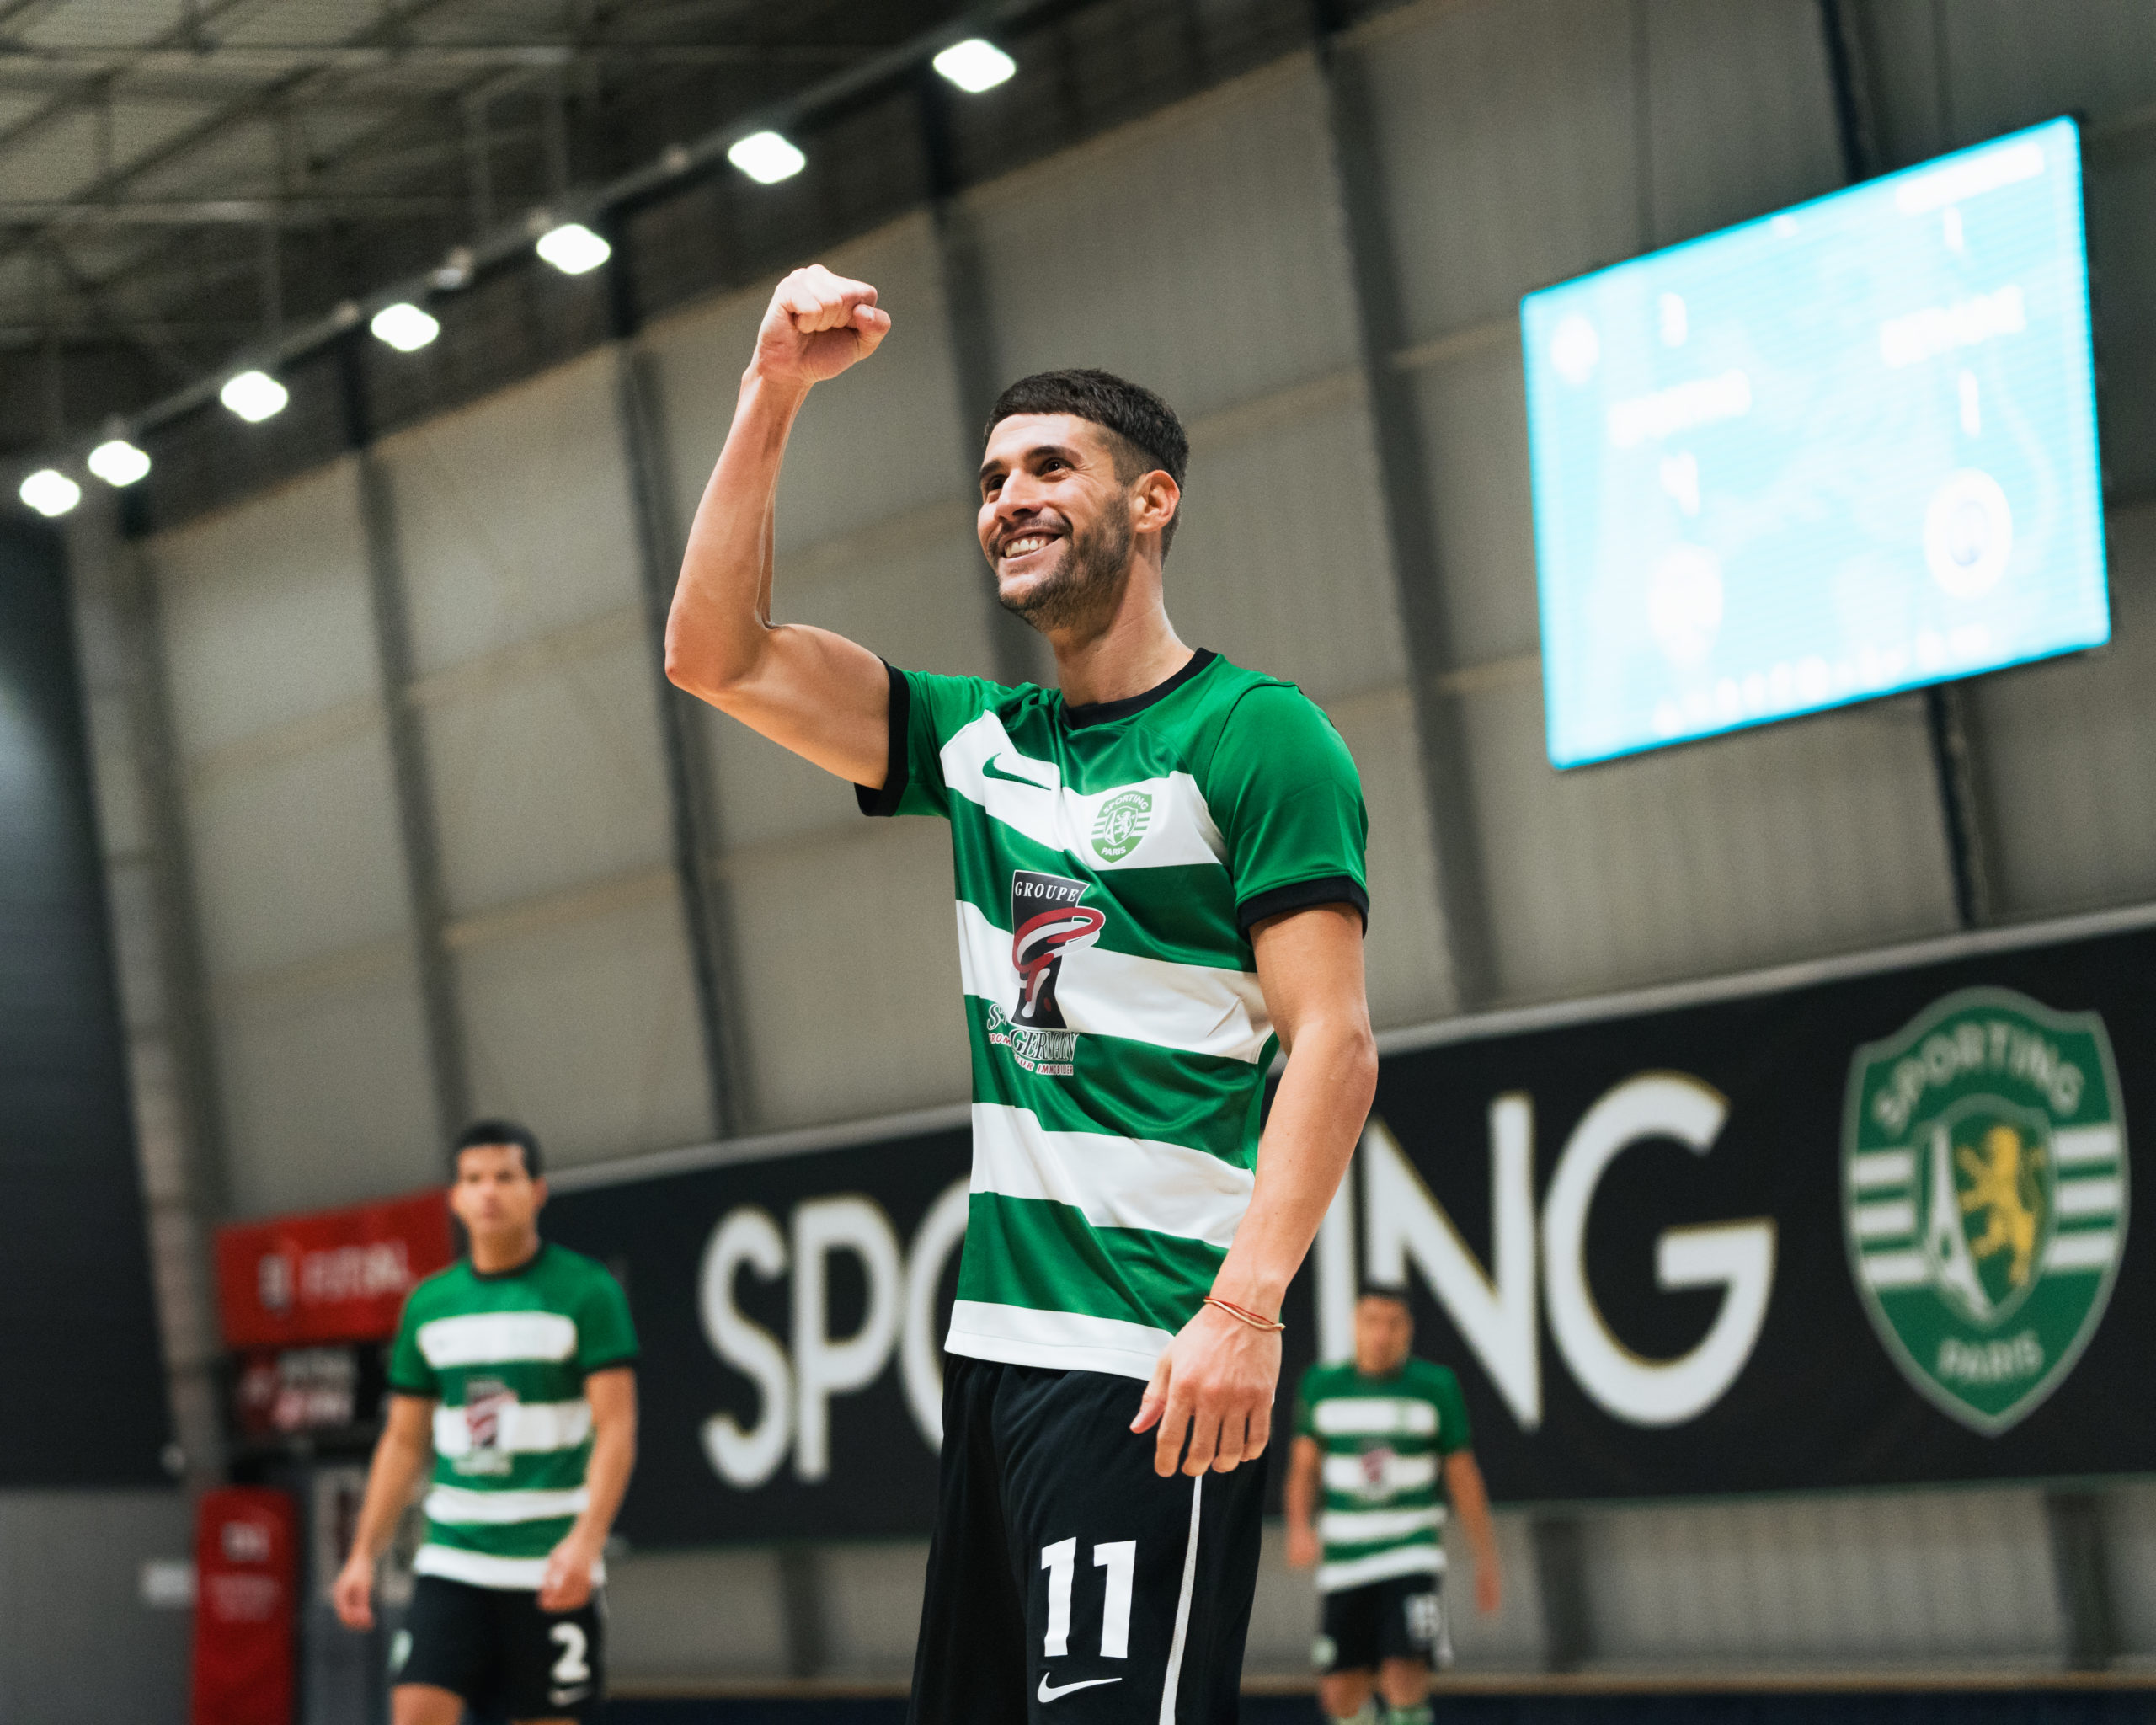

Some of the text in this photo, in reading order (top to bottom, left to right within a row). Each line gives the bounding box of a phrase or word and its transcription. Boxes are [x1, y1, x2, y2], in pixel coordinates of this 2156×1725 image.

[1103, 794, 1149, 814] SPORTING
[1101, 846, 1127, 856] PARIS
[1014, 881, 1079, 902] GROUPE
[1872, 1022, 2085, 1137] SPORTING
[1938, 1330, 2044, 1383] PARIS
[1041, 1536, 1137, 1658] 11
[549, 1621, 590, 1682] 2
